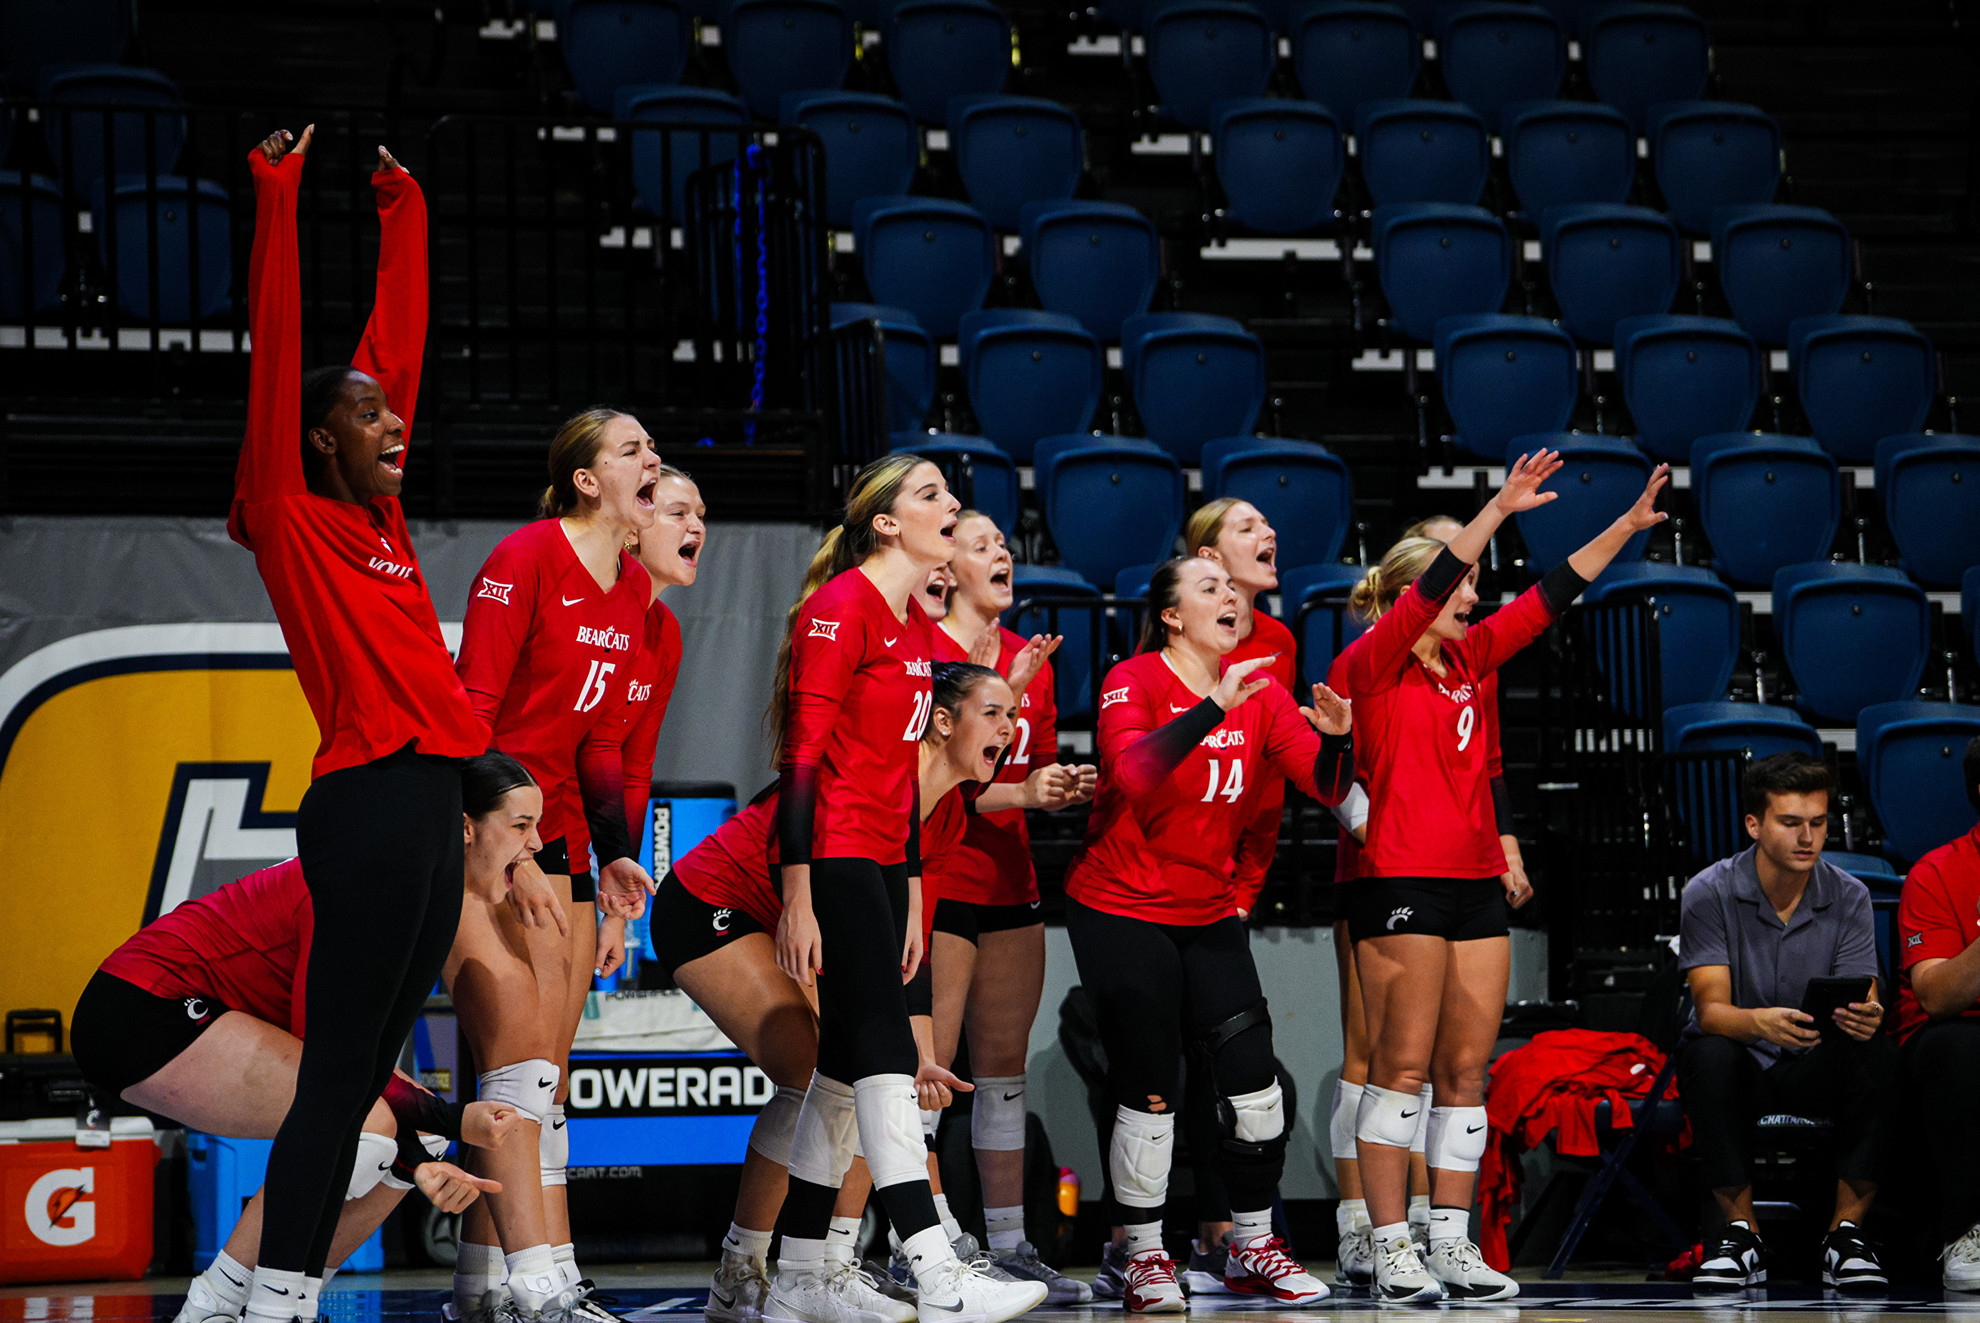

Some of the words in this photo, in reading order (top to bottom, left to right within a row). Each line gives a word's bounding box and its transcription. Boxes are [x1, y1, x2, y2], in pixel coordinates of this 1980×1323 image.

[576, 625, 630, 651] BEARCATS
[573, 660, 616, 713] 15
[902, 690, 933, 741] 20
[1457, 705, 1475, 752] 9
[1004, 718, 1030, 766] 2
[1201, 758, 1244, 803] 14
[568, 1066, 778, 1110] OWERAD
[25, 1167, 95, 1247] G
